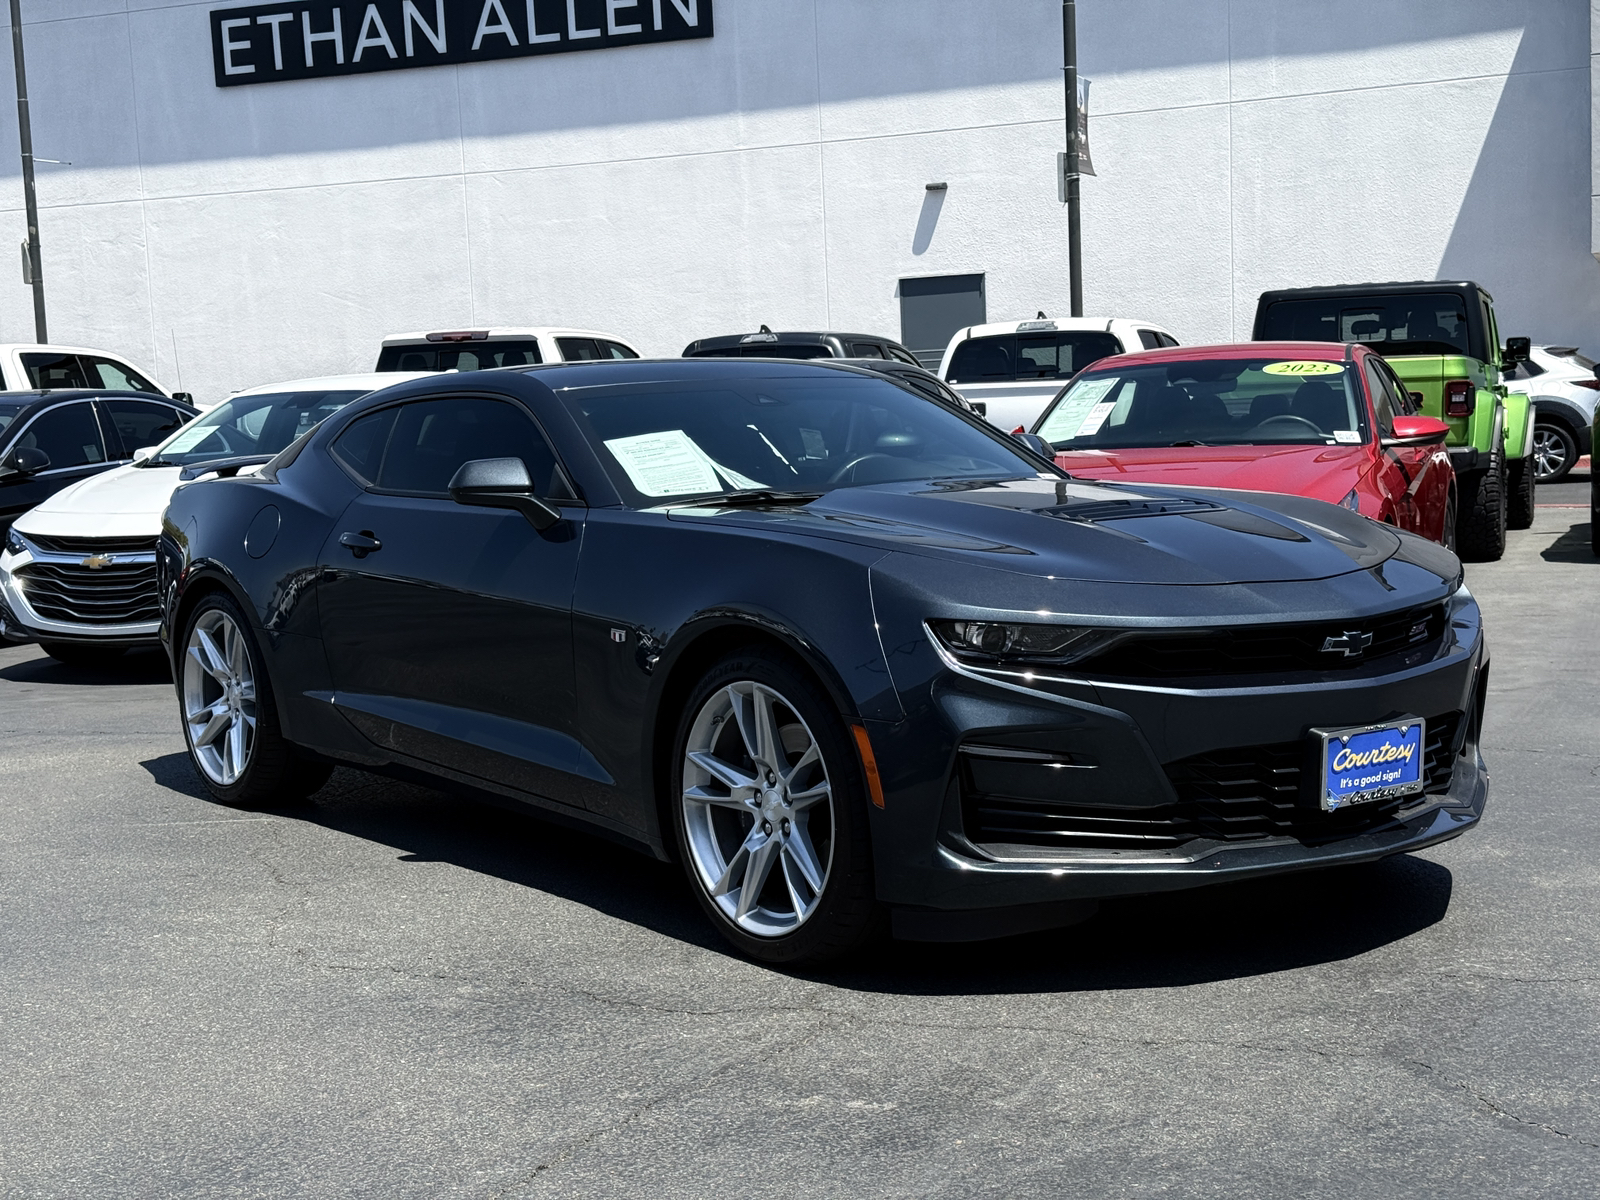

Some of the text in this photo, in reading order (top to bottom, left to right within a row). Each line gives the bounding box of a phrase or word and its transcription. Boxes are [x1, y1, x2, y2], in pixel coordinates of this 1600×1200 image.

[221, 0, 698, 75] ETHAN ALLEN
[1277, 364, 1330, 373] 2023
[1332, 741, 1416, 772] Courtesy
[1340, 778, 1353, 789] It's
[1360, 771, 1382, 787] good
[1382, 768, 1401, 782] sign!
